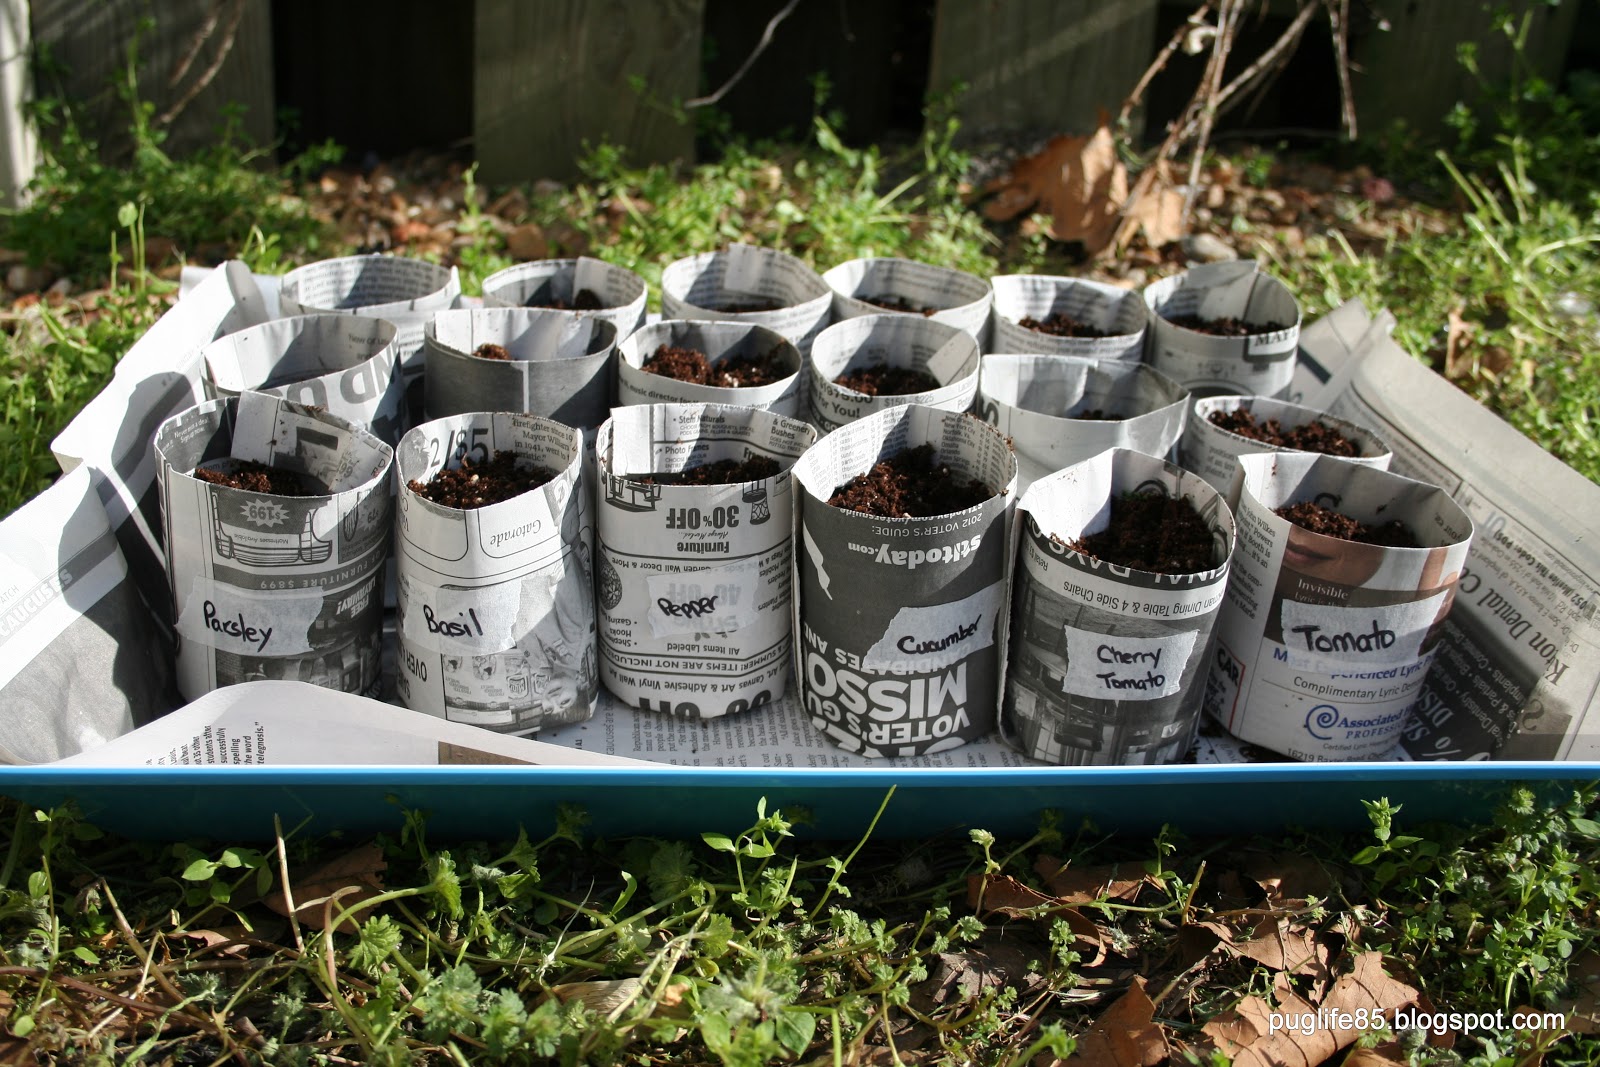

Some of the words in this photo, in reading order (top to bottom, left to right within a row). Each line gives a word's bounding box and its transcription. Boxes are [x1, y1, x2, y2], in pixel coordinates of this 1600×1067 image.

[648, 391, 678, 403] director
[831, 402, 860, 418] You!
[522, 430, 546, 443] Mayor
[771, 426, 795, 440] Bushes
[665, 446, 686, 454] Photo
[249, 506, 281, 521] $199
[666, 508, 701, 530] OFF
[703, 505, 740, 529] 30%
[962, 512, 983, 528] 2012
[490, 519, 542, 547] Gatorade
[871, 525, 910, 537] GUIDE:
[914, 522, 959, 537] VOTER'S
[1257, 515, 1276, 537] Wilkes
[1249, 535, 1265, 553] Booth
[1253, 527, 1273, 548] Powers
[677, 541, 730, 555] Furniture
[1511, 543, 1536, 567] Code:
[611, 557, 629, 568] More
[640, 562, 662, 571] Decor
[664, 564, 681, 573] Wall
[1532, 561, 1549, 578] This
[302, 562, 368, 588] FURNITURE
[260, 580, 294, 589] $899
[1063, 581, 1094, 602] Chairs
[1298, 578, 1349, 600] Invisible
[350, 595, 369, 619] FREE
[657, 595, 718, 619] Pepper
[1096, 593, 1119, 609] Side
[1121, 600, 1129, 611] 4
[1132, 602, 1140, 614] &
[1172, 601, 1202, 616] Dining
[1143, 603, 1170, 616] Table
[1477, 588, 1533, 640] Dental
[203, 600, 273, 652] Parsley
[423, 604, 484, 637] Basil
[897, 613, 982, 655] Cucumber
[1291, 619, 1396, 653] Tomato
[667, 643, 700, 653] Labeled
[703, 645, 726, 655] Items
[655, 660, 679, 668] NOT
[740, 650, 776, 671] SUMMER!
[1096, 644, 1162, 669] Cherry
[682, 661, 703, 670] ARE
[706, 662, 738, 671] ITEMS
[619, 674, 636, 687] Wall
[639, 678, 661, 690] Vinyl
[664, 682, 707, 693] Adhesive
[711, 684, 718, 692] &
[721, 683, 736, 692] Art
[738, 674, 765, 690] Canvas
[1096, 671, 1165, 691] Tomato
[1293, 676, 1378, 700] Complimentary
[1379, 686, 1399, 698] Lyric
[1488, 667, 1527, 704] Implants
[1468, 674, 1503, 707] Partials
[1337, 709, 1403, 728] Associated
[1461, 692, 1493, 729] Dentistry
[203, 725, 212, 739] after
[757, 724, 766, 737] head
[846, 707, 971, 745] VOTER'S
[632, 723, 642, 752] Republican
[724, 731, 733, 750] caucus
[759, 737, 767, 747] the
[769, 732, 779, 746] failed
[792, 732, 802, 747] place
[802, 721, 813, 748] supporter
[216, 727, 228, 764] successfully
[243, 735, 252, 753] word
[655, 734, 665, 752] people
[205, 739, 215, 764] students
[230, 738, 241, 765] spelling
